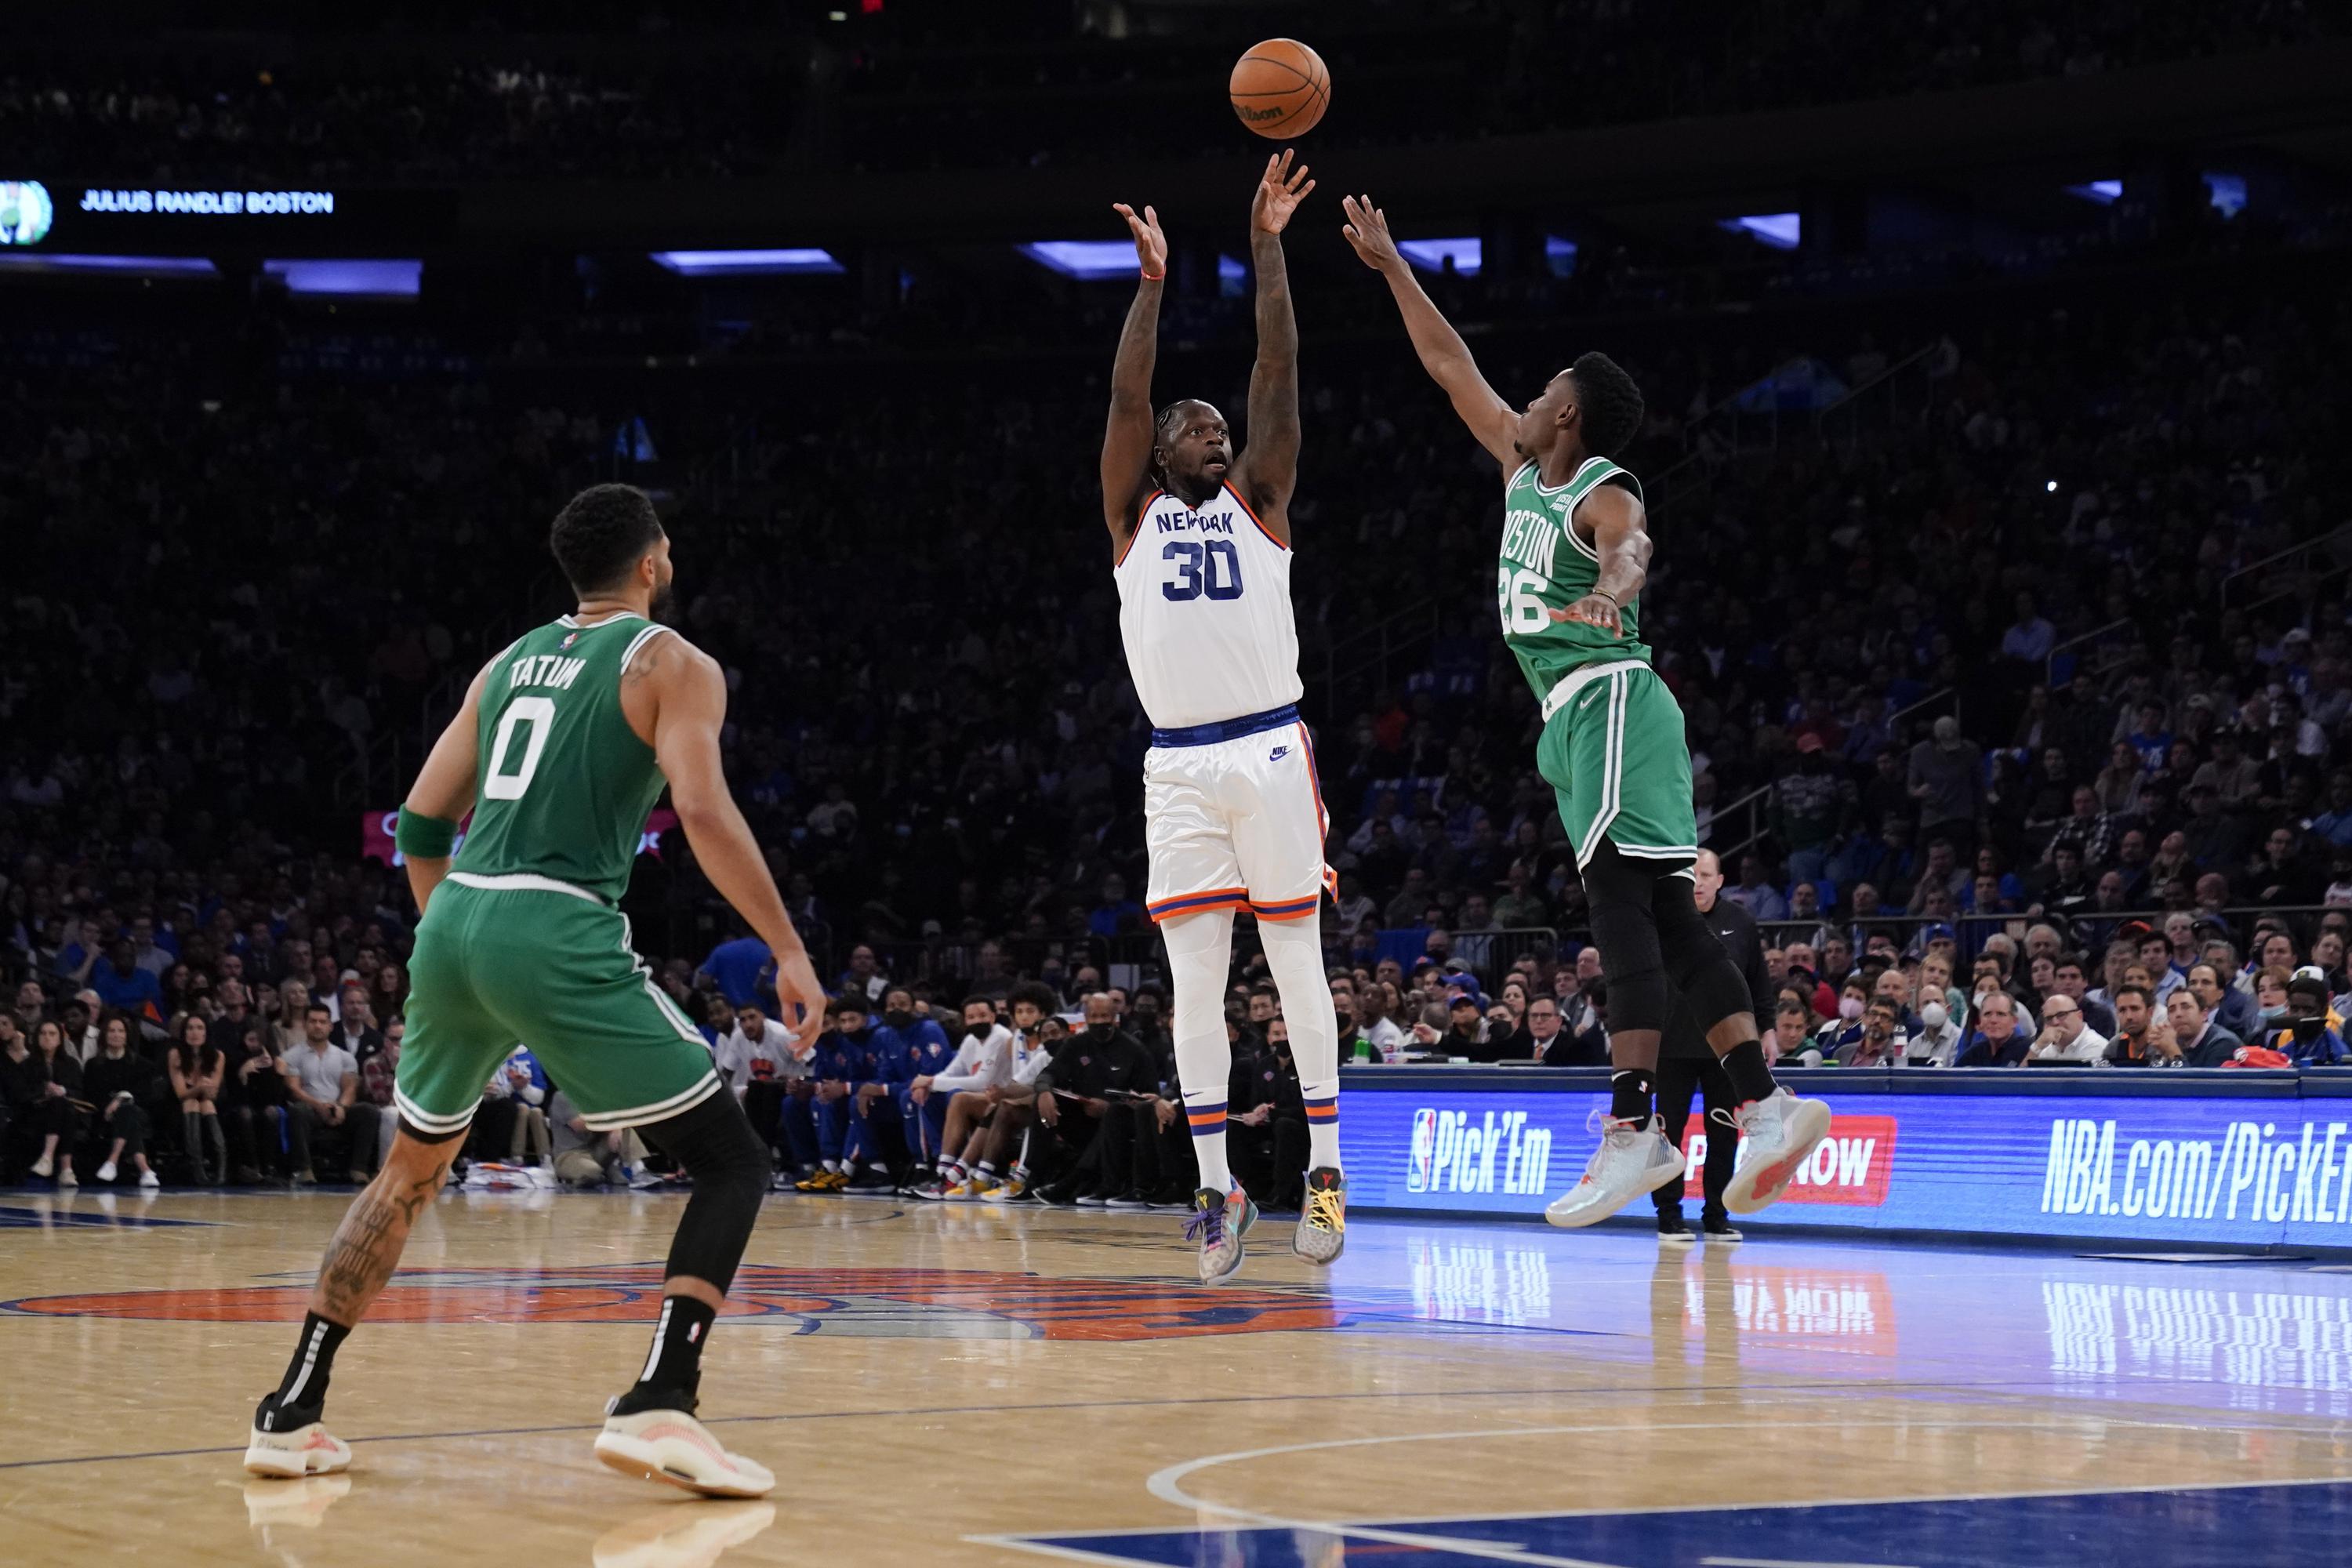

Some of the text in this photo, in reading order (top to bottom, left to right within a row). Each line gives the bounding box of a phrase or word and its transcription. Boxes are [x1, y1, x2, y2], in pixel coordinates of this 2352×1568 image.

[81, 190, 153, 212] JULIUS
[246, 191, 334, 213] BOSTON
[1198, 512, 1234, 534] ORK
[1163, 539, 1243, 601] 30
[510, 655, 586, 690] TATUM
[484, 696, 556, 800] 0
[1272, 746, 1287, 756] NIKE
